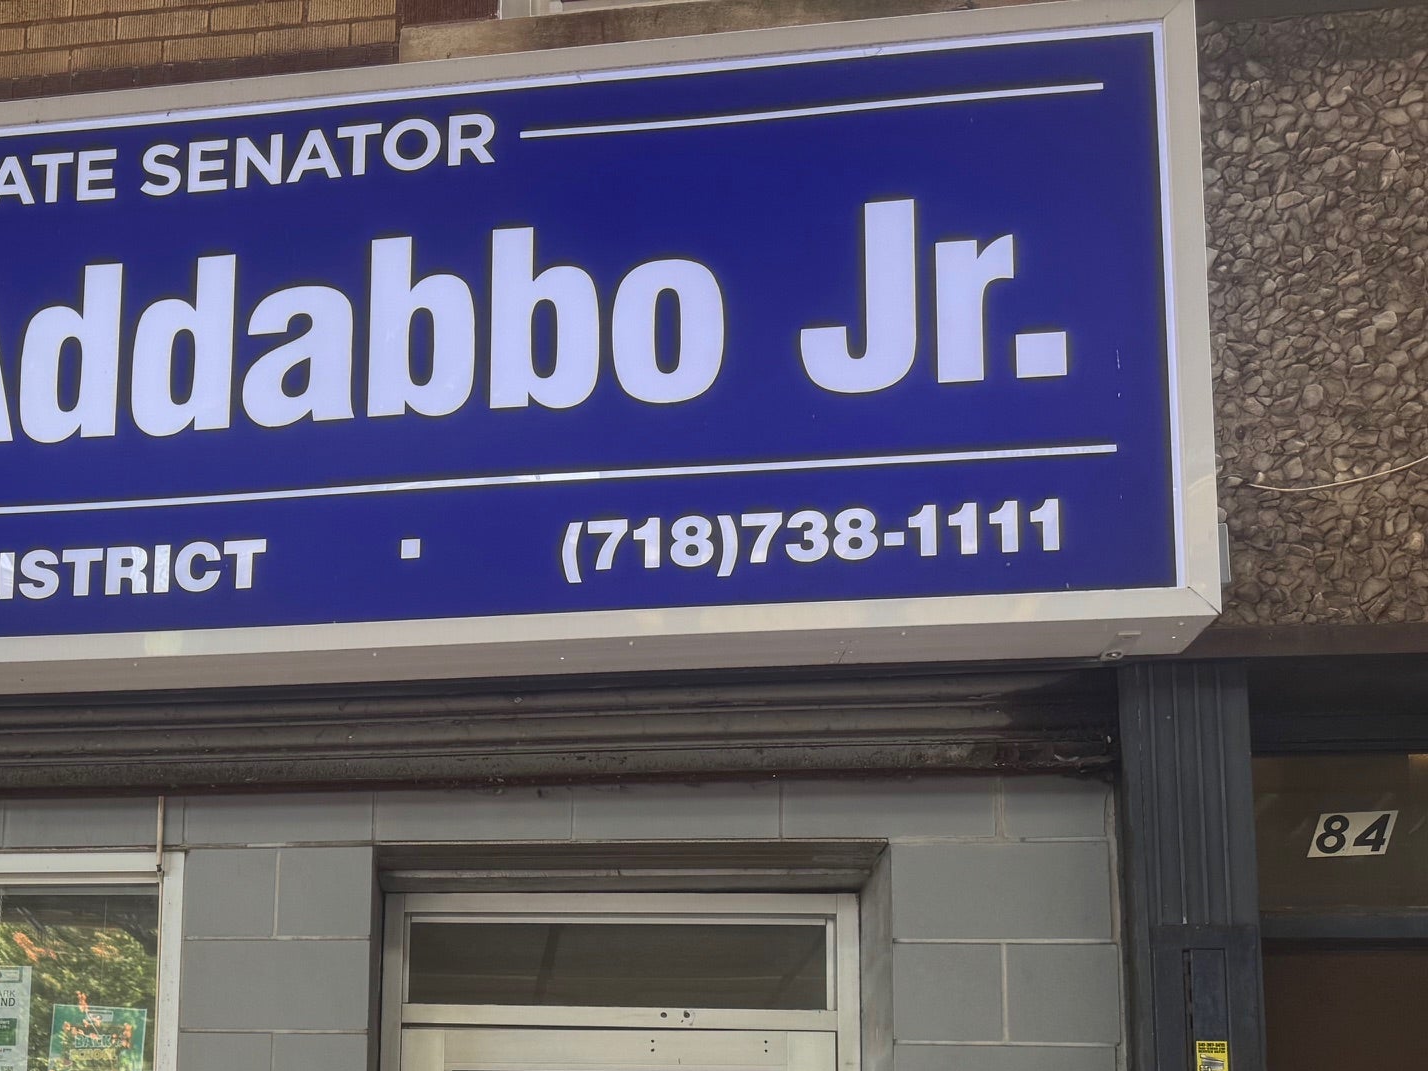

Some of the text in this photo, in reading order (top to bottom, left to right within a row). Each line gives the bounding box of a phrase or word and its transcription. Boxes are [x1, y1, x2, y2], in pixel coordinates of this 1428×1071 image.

[140, 113, 496, 197] SENATOR
[801, 199, 1068, 394] Jr.
[562, 498, 1061, 584] (718)738-1111
[1316, 813, 1391, 854] 84
